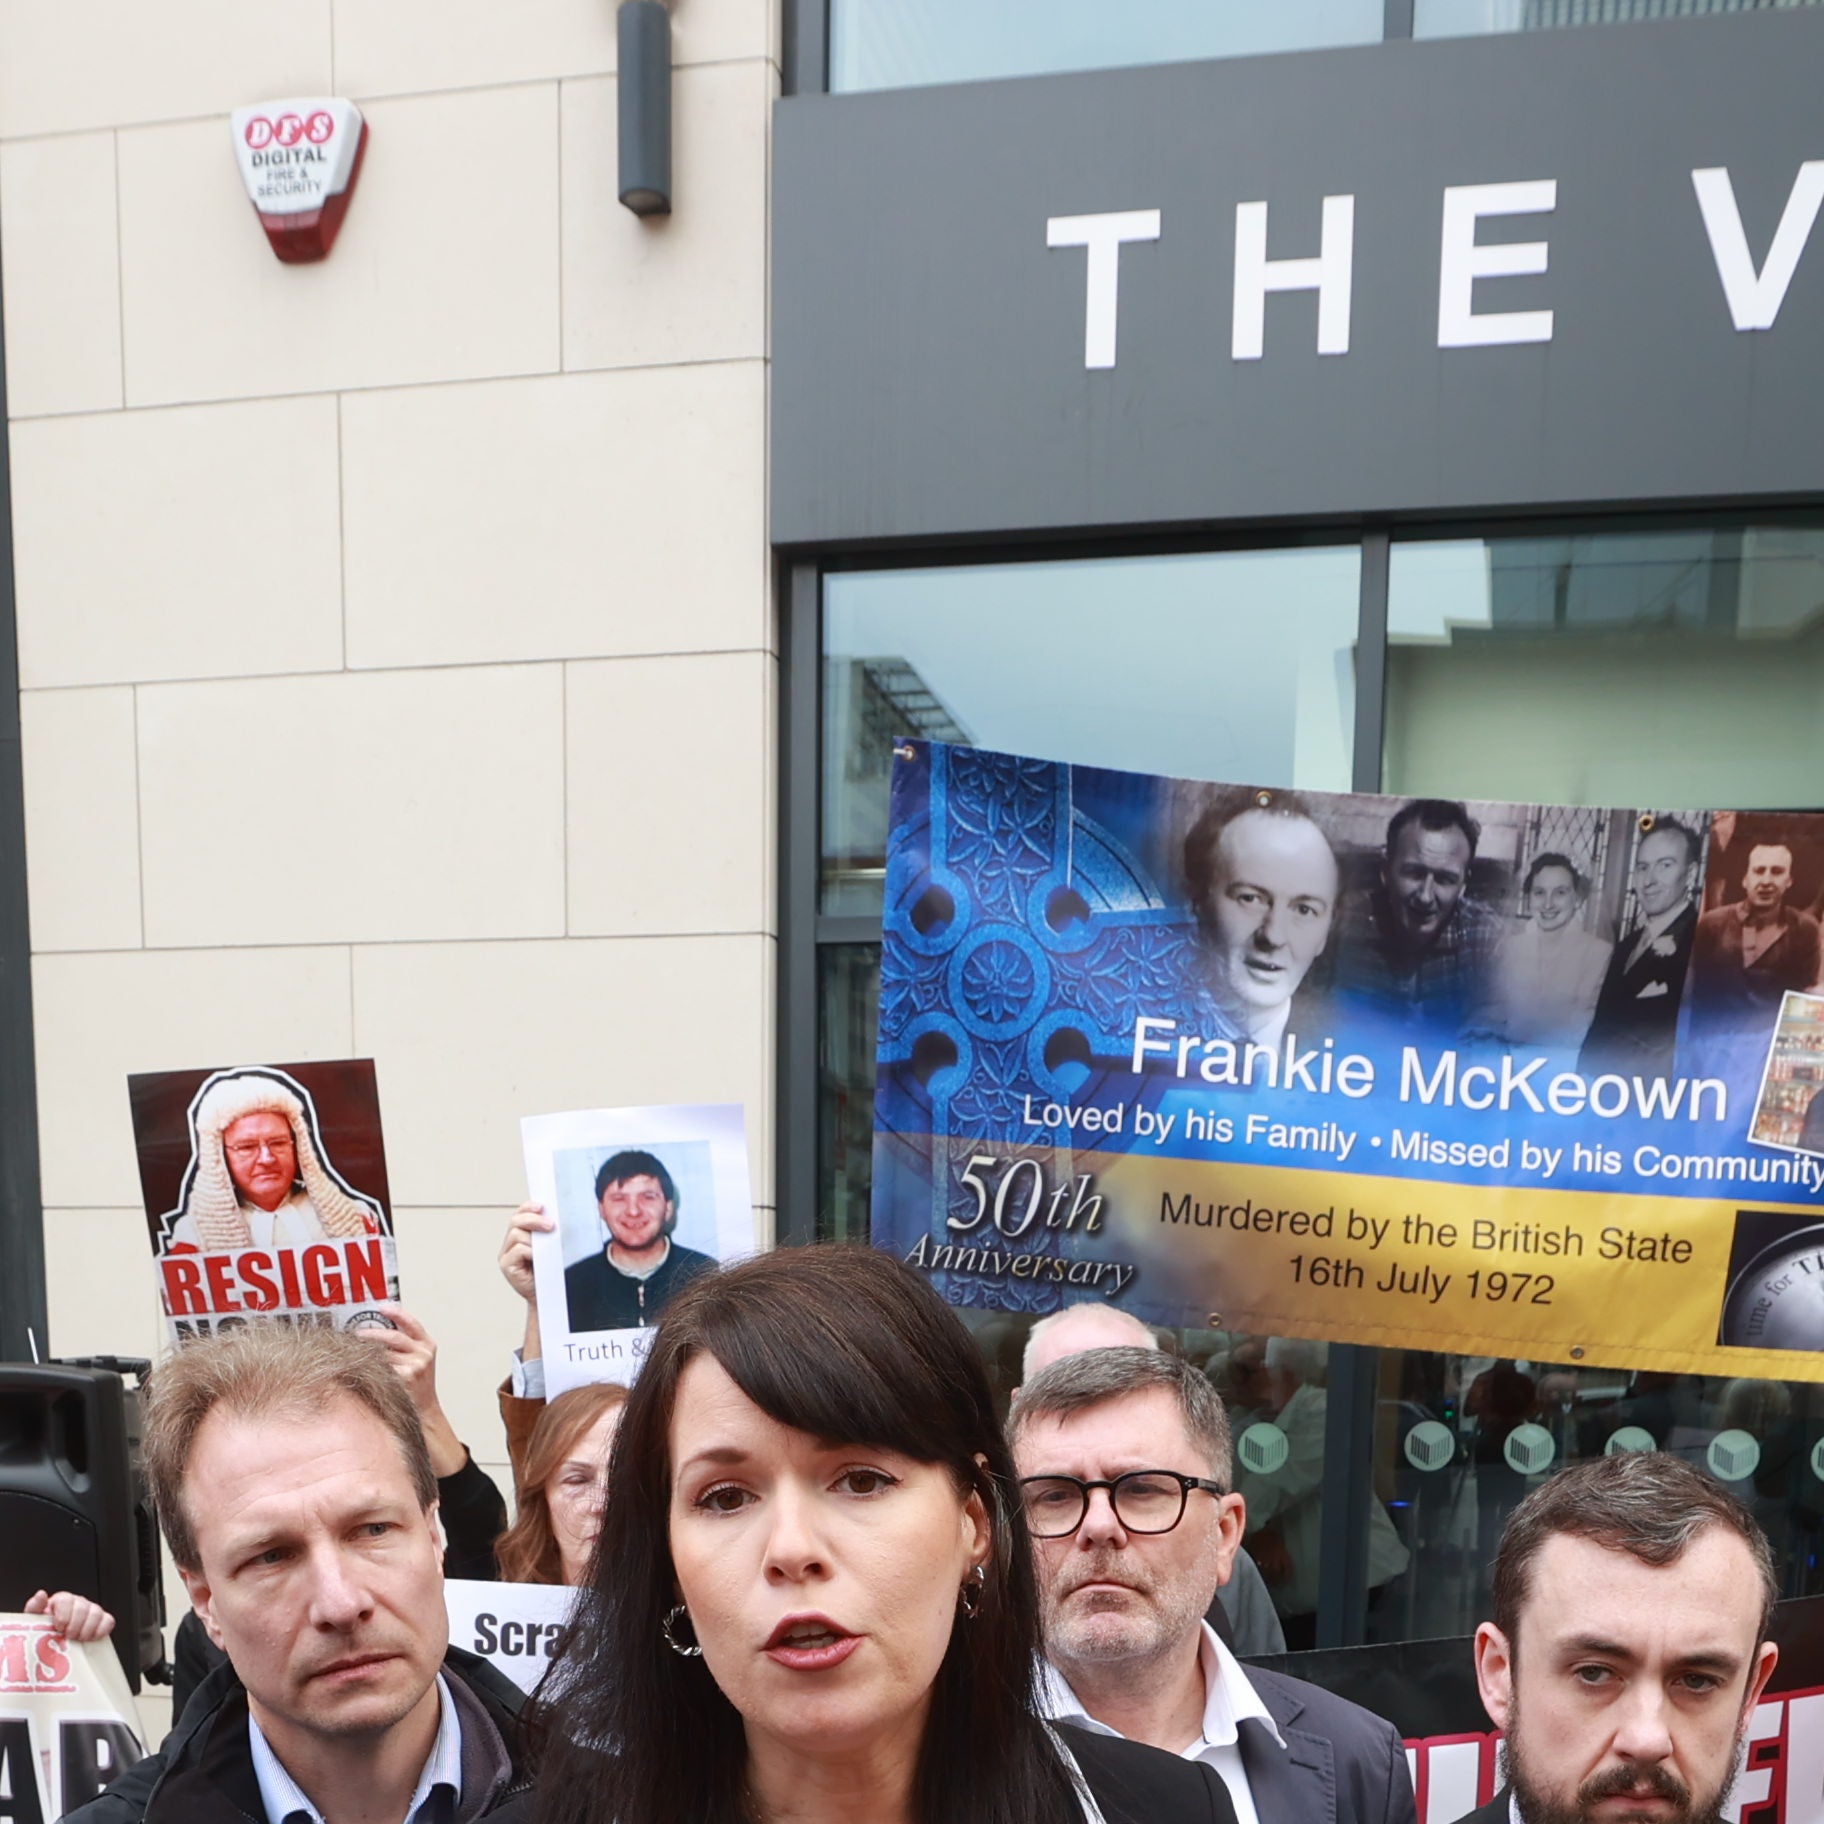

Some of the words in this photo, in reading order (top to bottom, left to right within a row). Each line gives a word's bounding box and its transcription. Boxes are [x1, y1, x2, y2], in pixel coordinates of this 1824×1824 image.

[252, 147, 327, 167] DIGITAL
[267, 169, 294, 181] FIRE
[300, 168, 309, 178] &
[257, 181, 322, 196] SECURITY
[1047, 179, 1557, 369] THE
[1131, 1015, 1375, 1098] Frankie
[1400, 1046, 1727, 1121] McKeown
[1024, 1094, 1123, 1133] Loved
[1135, 1106, 1175, 1144] by
[1185, 1109, 1233, 1142] his
[1246, 1114, 1356, 1161] Family
[1391, 1129, 1509, 1168] Missed
[1521, 1141, 1562, 1178] by
[1573, 1143, 1622, 1174] his
[947, 1156, 1103, 1237] 50th
[1160, 1192, 1334, 1238] Murdered
[1347, 1209, 1390, 1250] by
[1403, 1215, 1458, 1248] the
[1474, 1220, 1583, 1257] British
[1598, 1228, 1693, 1263] State
[161, 1239, 388, 1316] RESIGN
[905, 1232, 1134, 1295] Anniversary
[1290, 1255, 1363, 1289] 16th
[1377, 1262, 1451, 1304] July
[1467, 1270, 1555, 1304] 1972
[1746, 1298, 1773, 1336] time
[1765, 1274, 1794, 1296] for
[564, 1340, 622, 1362] Truth
[631, 1338, 648, 1357] &
[474, 1613, 567, 1657] Scra
